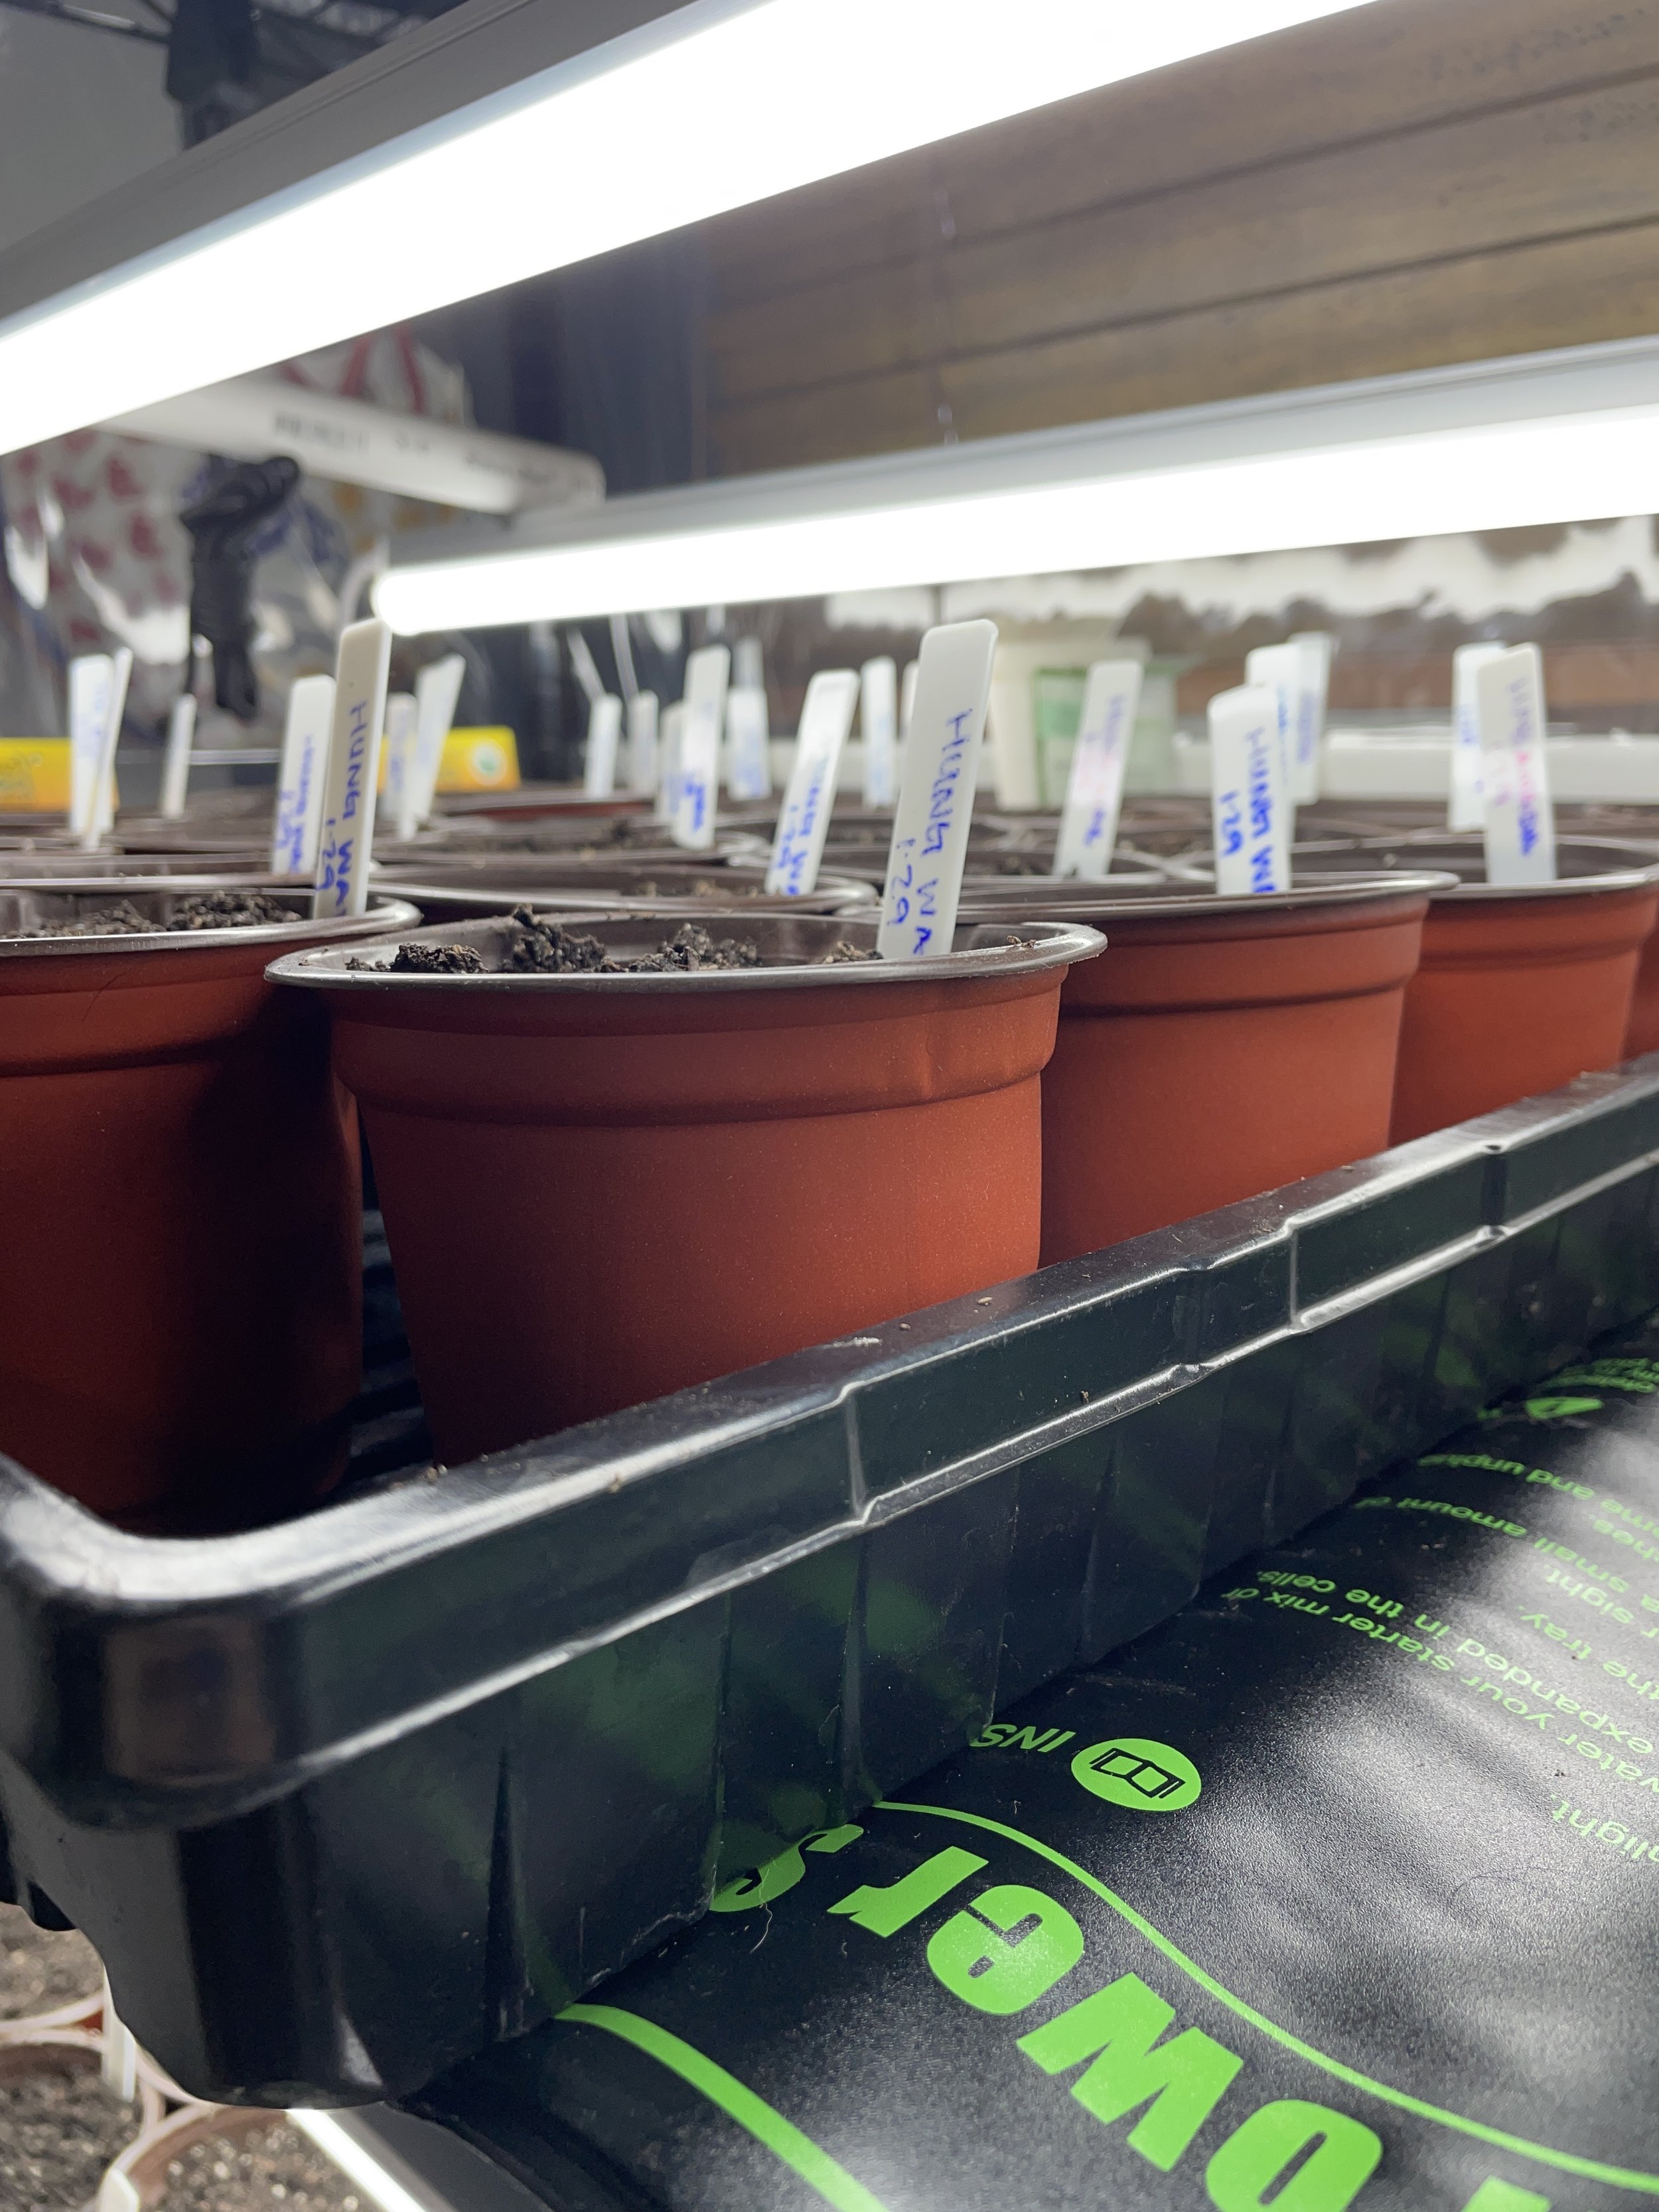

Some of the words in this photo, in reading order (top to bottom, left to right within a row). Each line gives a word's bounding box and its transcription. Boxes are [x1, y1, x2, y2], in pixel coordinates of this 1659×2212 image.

[342, 701, 367, 820] HUNG
[922, 708, 973, 856] HUNG
[1526, 1469, 1595, 1501] and
[1396, 1499, 1528, 1537] amount
[1533, 1536, 1629, 1593] small
[1221, 1587, 1260, 1599] or
[1263, 1591, 1331, 1616] mix
[1344, 1587, 1405, 1619] the
[1543, 1564, 1634, 1625] sight.
[1331, 1612, 1457, 1673] starter
[1413, 1613, 1452, 1641] in
[1518, 1605, 1594, 1660] tray.
[1455, 1639, 1654, 1755] expanded
[1459, 1673, 1555, 1731] your
